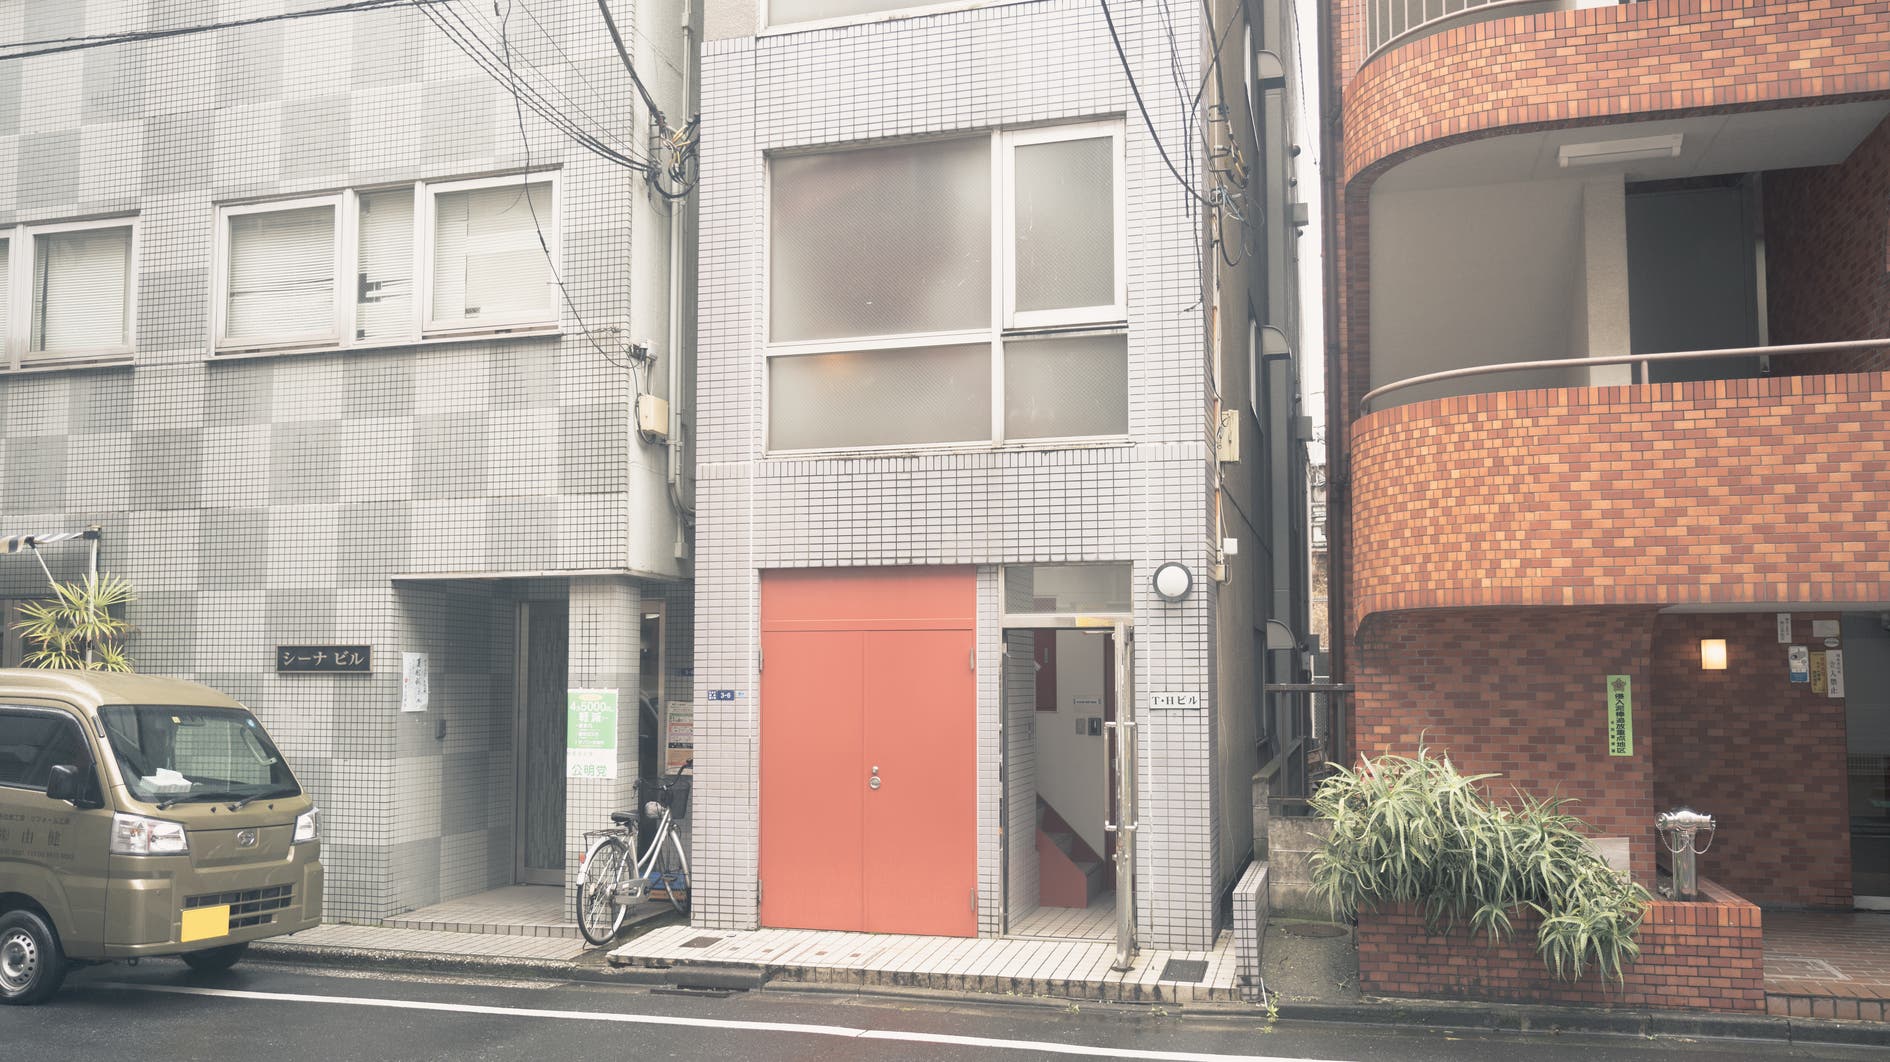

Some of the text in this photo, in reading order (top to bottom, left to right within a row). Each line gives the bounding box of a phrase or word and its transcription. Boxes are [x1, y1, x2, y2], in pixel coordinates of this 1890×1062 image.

[283, 650, 365, 666] シーナ ビル
[571, 764, 607, 777] 公明党
